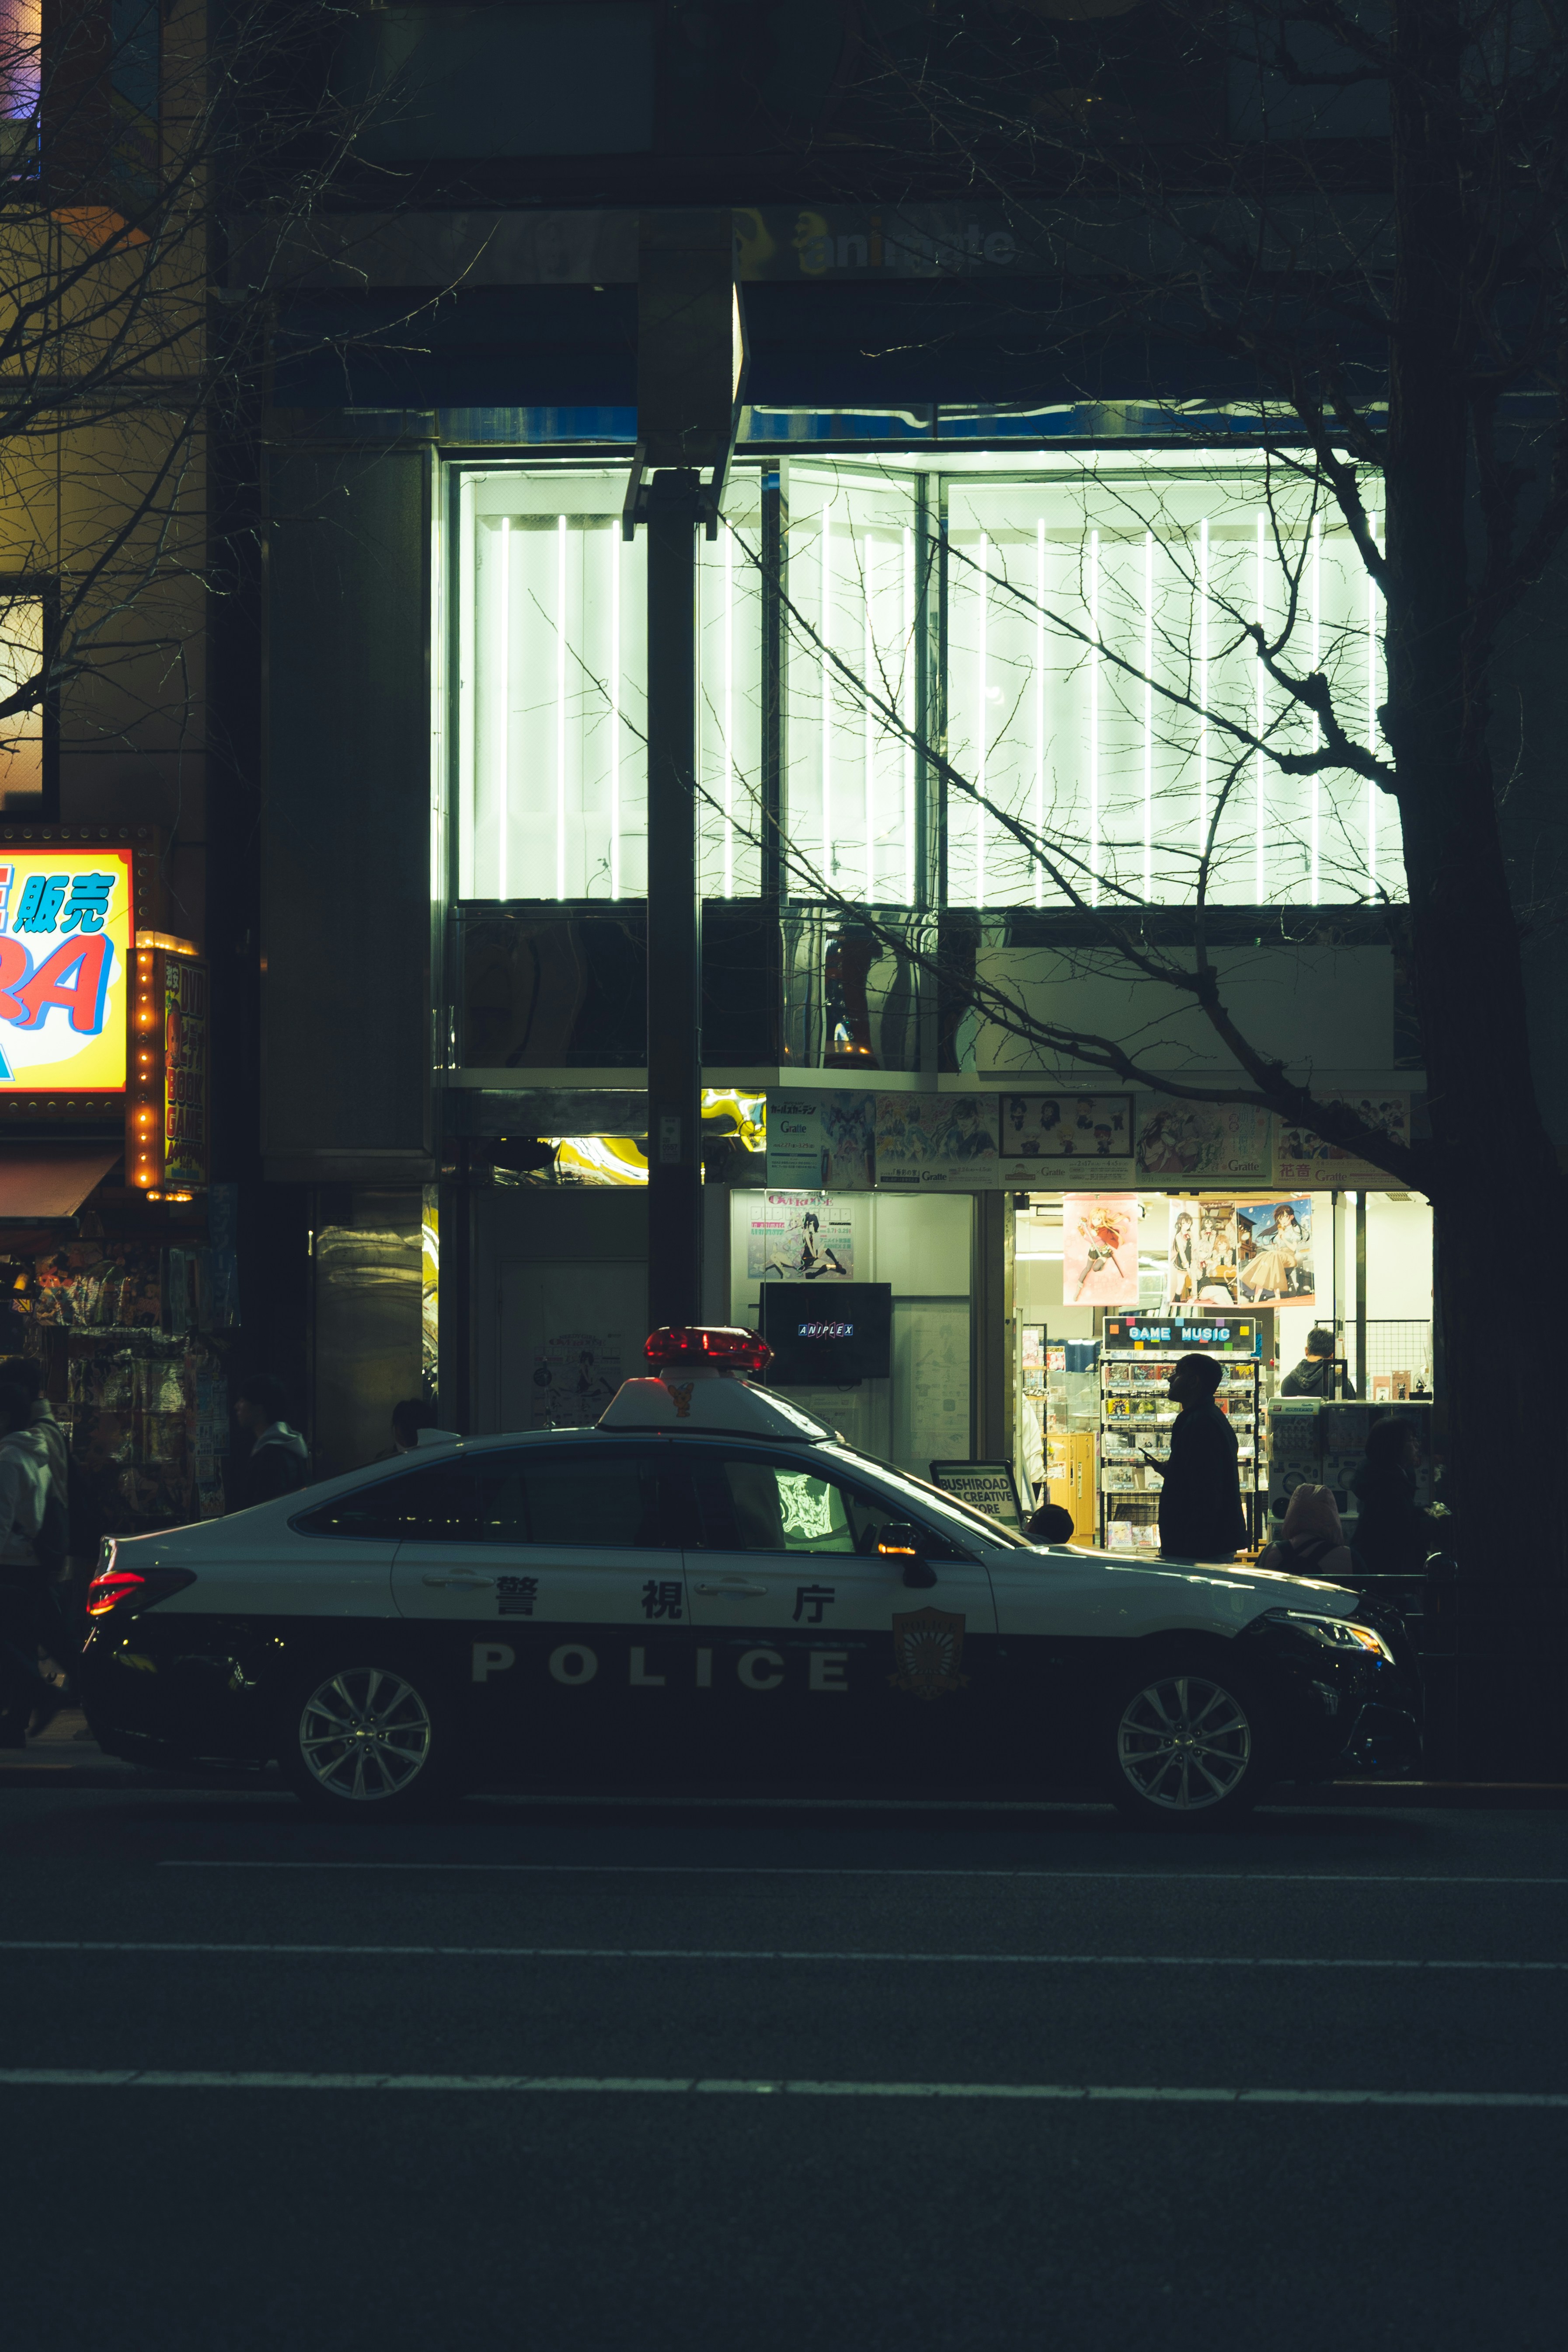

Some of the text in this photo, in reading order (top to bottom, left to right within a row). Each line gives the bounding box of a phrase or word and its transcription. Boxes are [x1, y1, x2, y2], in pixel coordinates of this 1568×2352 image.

[806, 216, 1016, 267] animate
[12, 873, 115, 933] 販売
[180, 965, 205, 1017] DVD
[167, 1066, 203, 1107] BOOK
[770, 1104, 816, 1115] ガールズガーデン
[166, 1106, 203, 1143] GAME
[781, 1120, 807, 1133] Gratte
[1041, 1167, 1066, 1176] Gratte
[1228, 1159, 1259, 1171] Gratte
[1279, 1163, 1311, 1178] 花音
[922, 1171, 947, 1181] Gratte
[1315, 1170, 1347, 1181] Gratte
[799, 1324, 853, 1336] ANIPLEX
[1129, 1327, 1230, 1341] GAME MUSIC
[940, 1478, 1009, 1491] BUSHIROAD
[963, 1491, 1013, 1502] CREATIVE
[972, 1504, 1000, 1514] TORE
[900, 1620, 958, 1634] POLICE
[471, 1643, 849, 1691] POLICE
